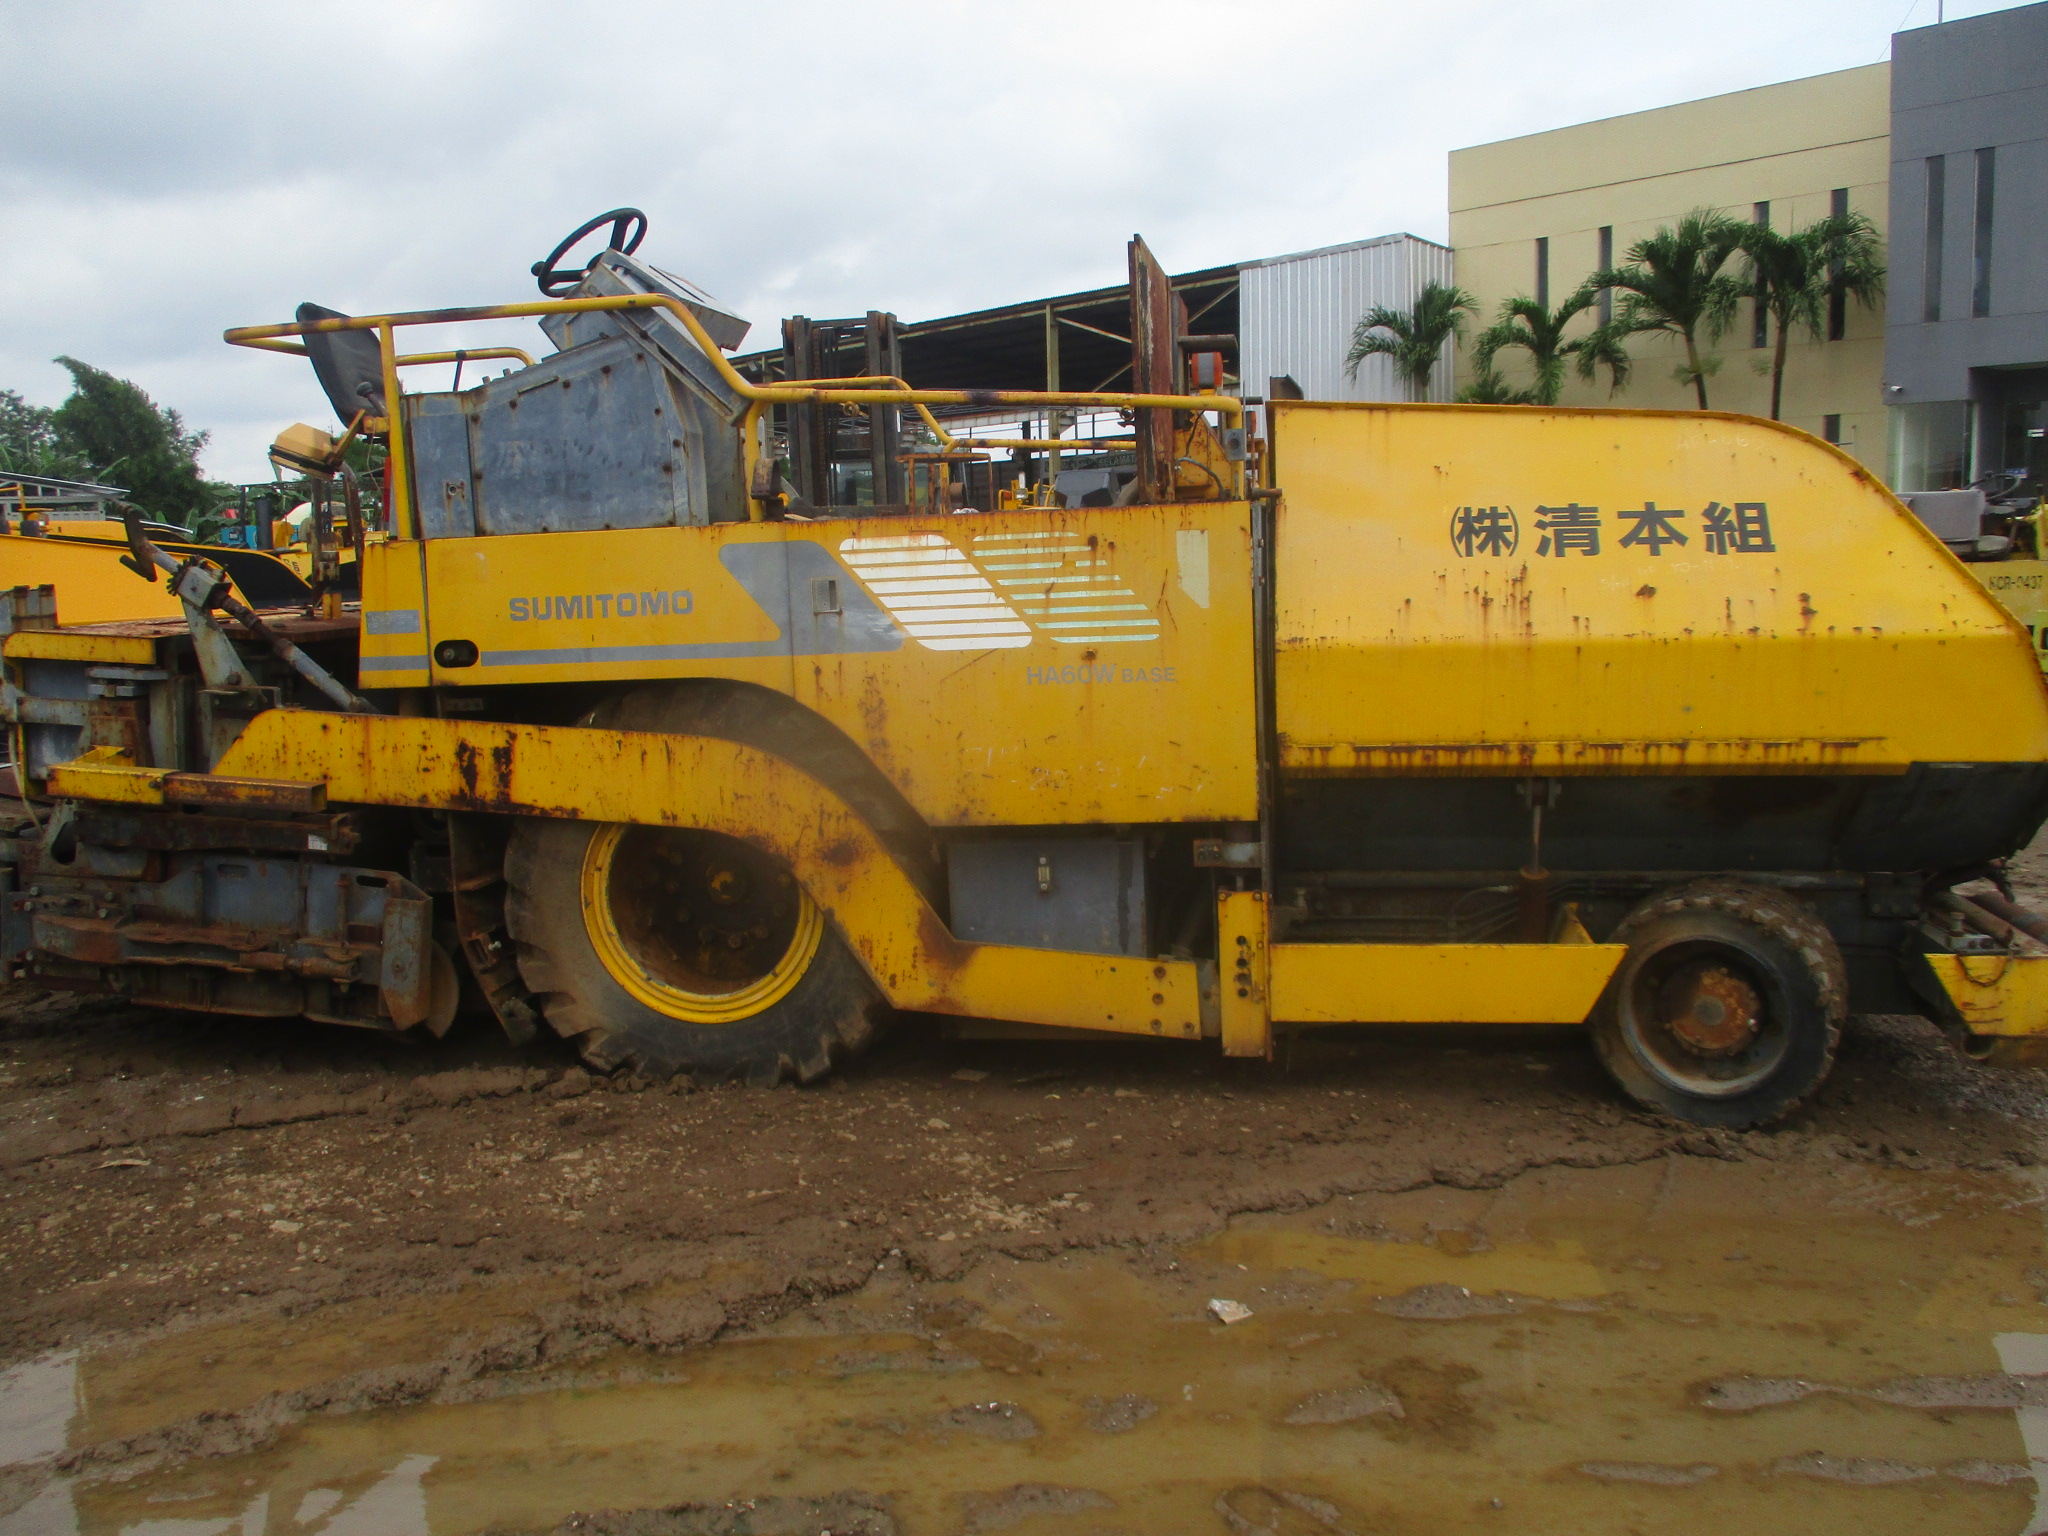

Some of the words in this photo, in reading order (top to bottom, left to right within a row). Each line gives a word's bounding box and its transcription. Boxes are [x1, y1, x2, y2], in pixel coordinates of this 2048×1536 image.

[509, 590, 694, 622] SUMITOMO
[1027, 663, 1117, 686] HA60W
[1121, 667, 1176, 684] BASE
